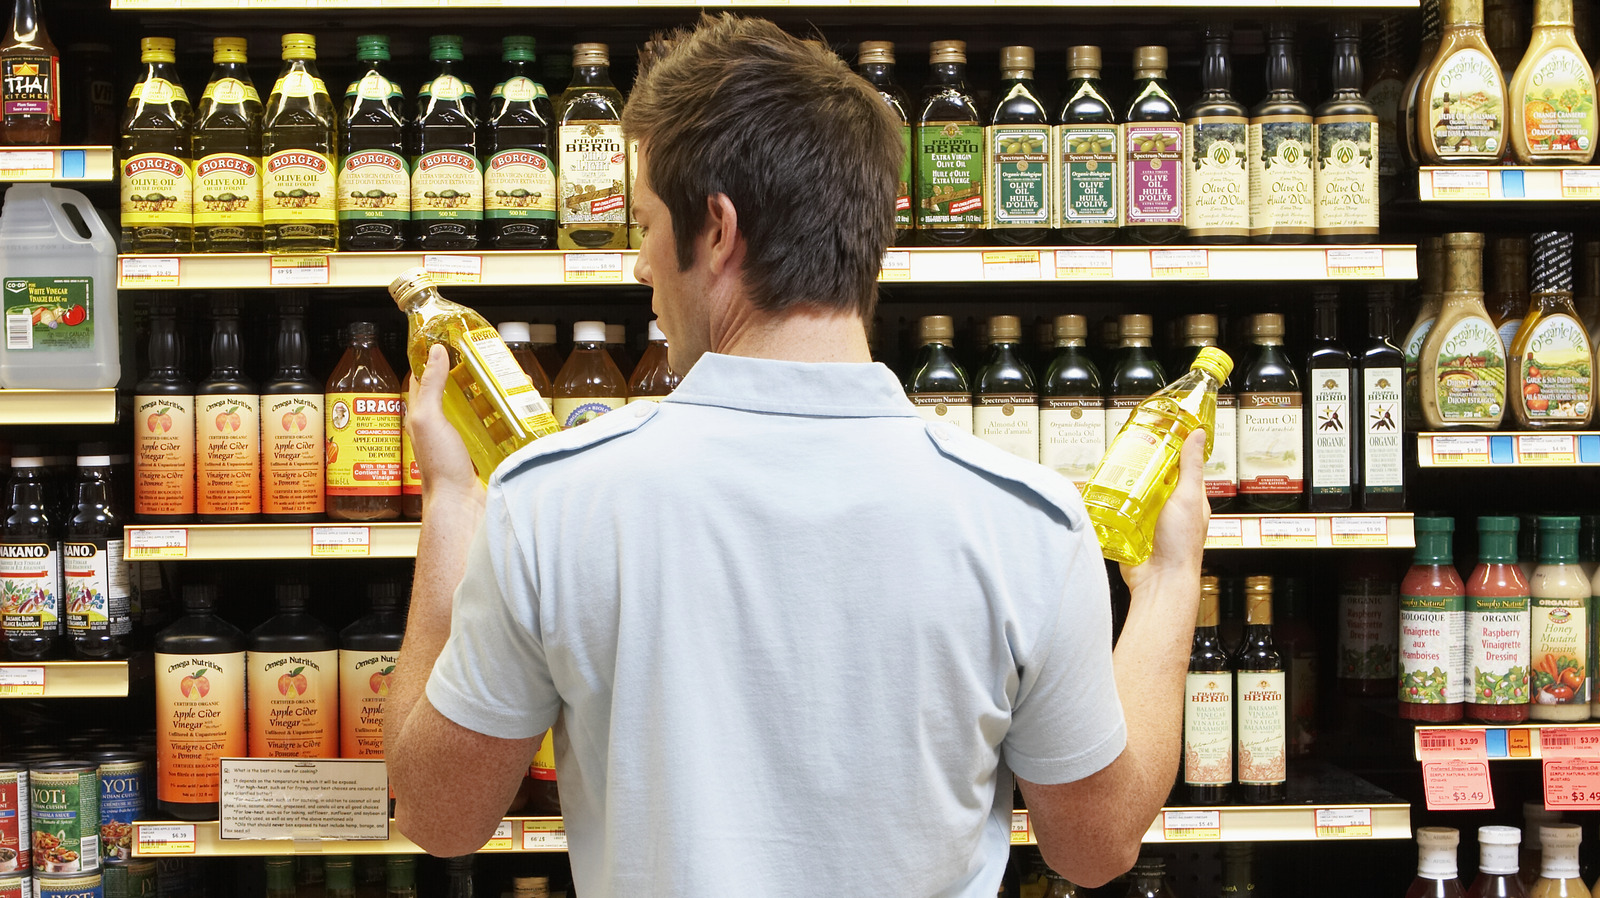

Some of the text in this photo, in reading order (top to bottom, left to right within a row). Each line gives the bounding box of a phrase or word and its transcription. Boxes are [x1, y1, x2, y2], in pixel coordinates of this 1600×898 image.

[4, 77, 48, 93] THAI
[566, 144, 620, 152] BERIO
[924, 145, 978, 153] BERIO
[131, 159, 176, 171] BORGES
[203, 159, 247, 171] BORGES
[274, 155, 319, 167] BORGES
[353, 154, 396, 166] BORGES
[426, 154, 469, 166] BORGES
[498, 154, 540, 165] BORGES
[1202, 182, 1240, 192] Olive Oil
[1326, 182, 1365, 192] Olive Oil
[1445, 323, 1497, 354] OrganicVille
[1532, 322, 1583, 353] OrganicVille
[205, 398, 252, 412] Omega Nutrition
[272, 398, 319, 412] Omega Nutrition
[1252, 395, 1291, 404] Spectrum
[139, 399, 185, 413] Omega Nutrition
[568, 407, 587, 426] ORGANIC
[1245, 414, 1297, 425] Peanut Oil
[141, 441, 158, 452] Apple
[1317, 437, 1346, 447] ORGANIC
[1369, 436, 1398, 446] ORGANIC
[141, 452, 165, 461] Vinegar
[1476, 600, 1525, 608] Simply Natural
[1403, 627, 1440, 638] Vinaigrette
[1482, 627, 1520, 638] Raspberry
[1545, 624, 1573, 635] Honey
[1541, 634, 1576, 643] Mustard
[1482, 639, 1521, 650] Vinaigrette
[1541, 644, 1576, 655] Dressing
[1486, 651, 1518, 662] Dressing
[168, 658, 223, 674] Omega Nutrition
[264, 656, 320, 672] Omega Nutrition
[173, 708, 221, 720] Apple Cider
[173, 720, 203, 731] Vinegar
[1453, 792, 1483, 801] $3.49
[1572, 792, 1600, 802] $3.49
